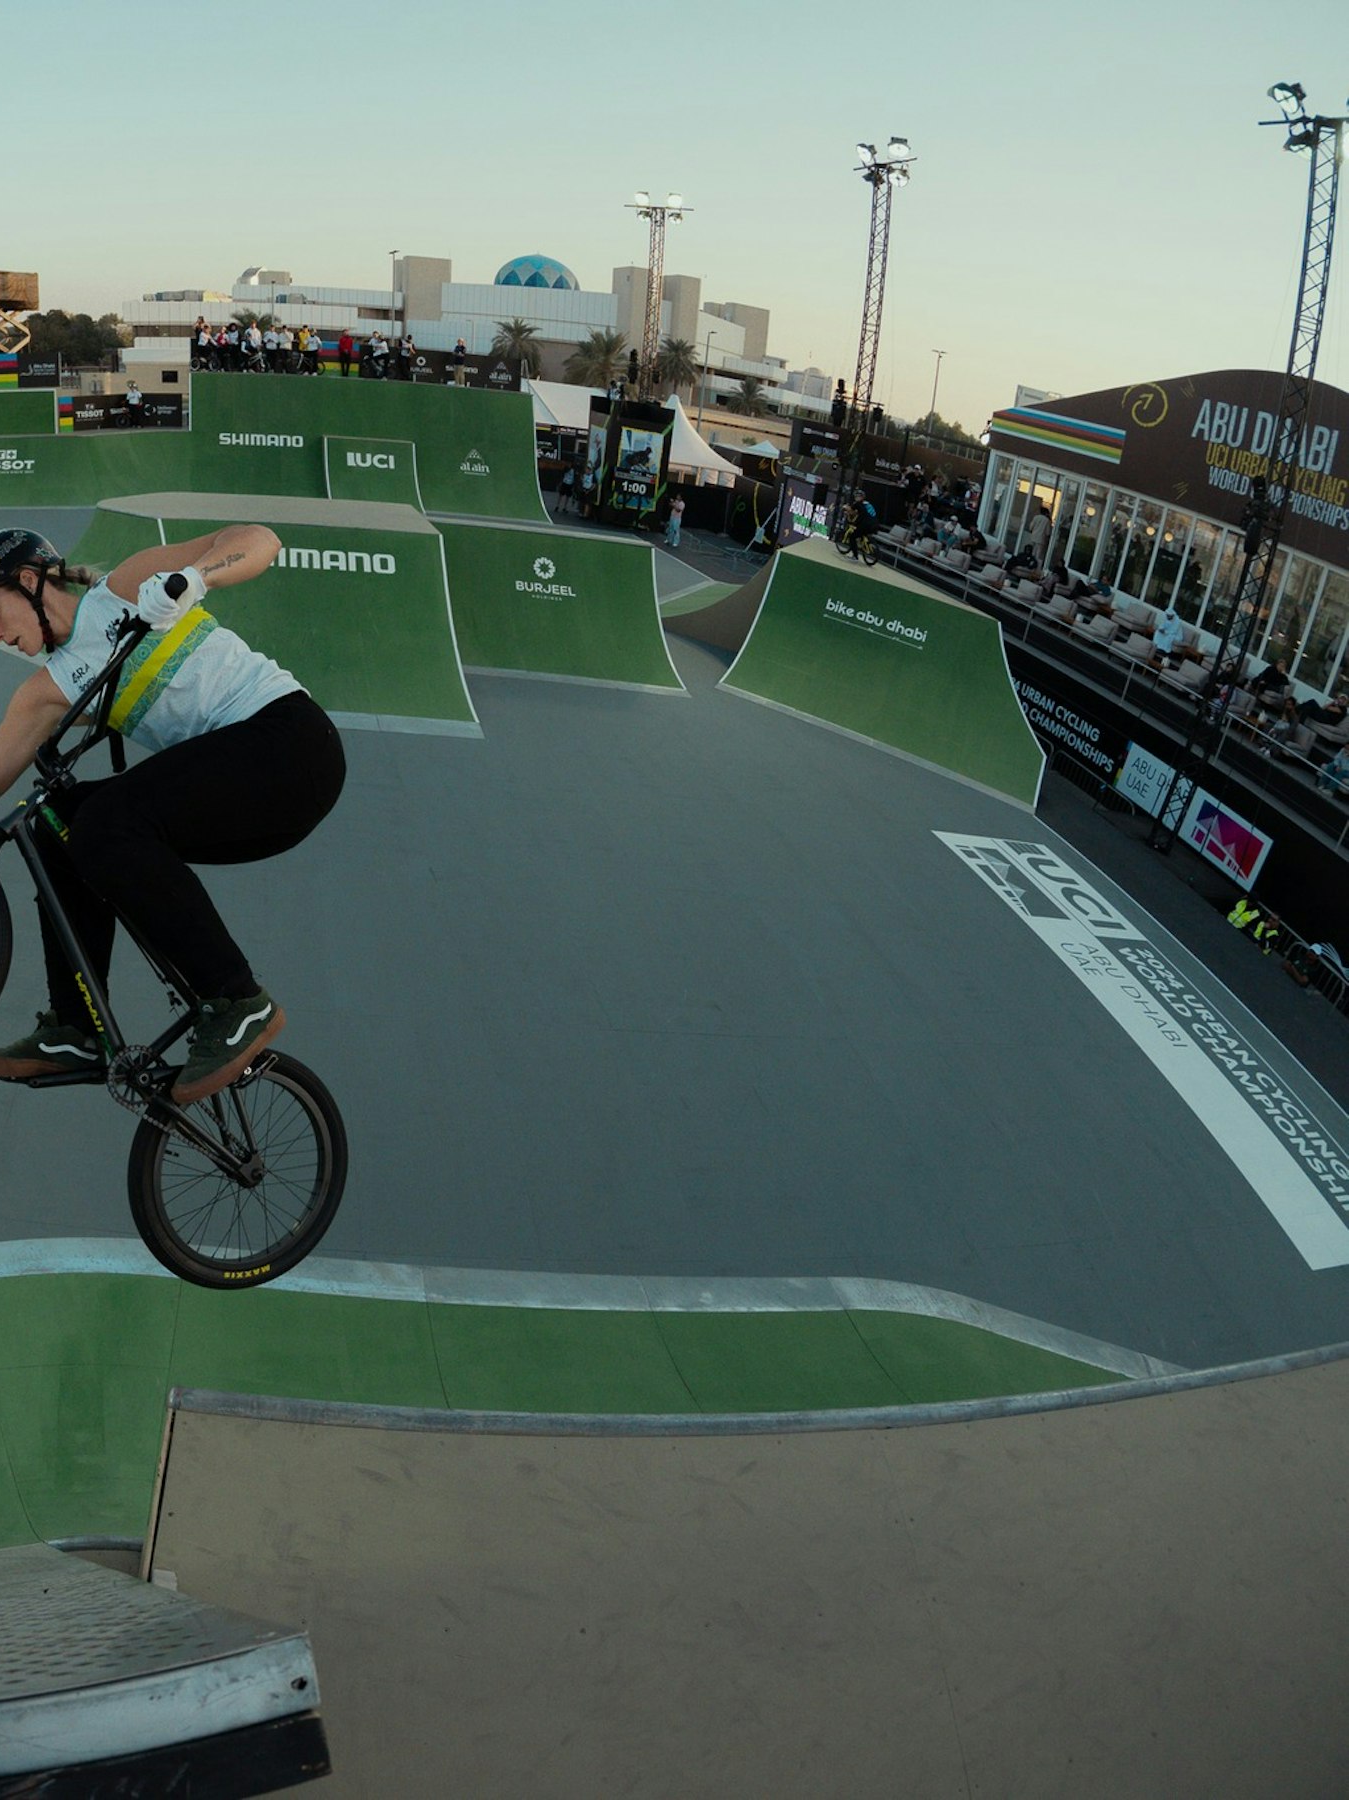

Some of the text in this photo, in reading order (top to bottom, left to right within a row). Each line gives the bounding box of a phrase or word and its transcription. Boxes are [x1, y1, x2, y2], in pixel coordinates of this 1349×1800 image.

[75, 408, 105, 418] TISSOT
[1191, 398, 1249, 448] ABU
[218, 432, 304, 448] SHIMANO
[354, 452, 396, 469] UCI
[460, 462, 491, 473] al ain
[1205, 441, 1230, 468] UCI
[622, 481, 647, 495] 1:00
[1208, 465, 1250, 496] WORLD
[270, 547, 396, 575] IMANO
[515, 580, 576, 597] BURJEEL
[824, 597, 928, 644] bike abu dhabi
[1021, 683, 1055, 713] URBAN
[1055, 705, 1101, 742] CYCLING
[1029, 709, 1115, 774] CHAMPIONSHIPS
[1131, 757, 1156, 779] ABU
[1125, 774, 1150, 798] UAE
[1022, 854, 1128, 931] UCI
[1061, 942, 1103, 976] UAE
[1078, 942, 1188, 1048] ABU DHABI
[1118, 947, 1193, 1018] WORLD
[1135, 947, 1349, 1181] 2024 URBAN CYCLING
[223, 1263, 272, 1280] MAXXIS
